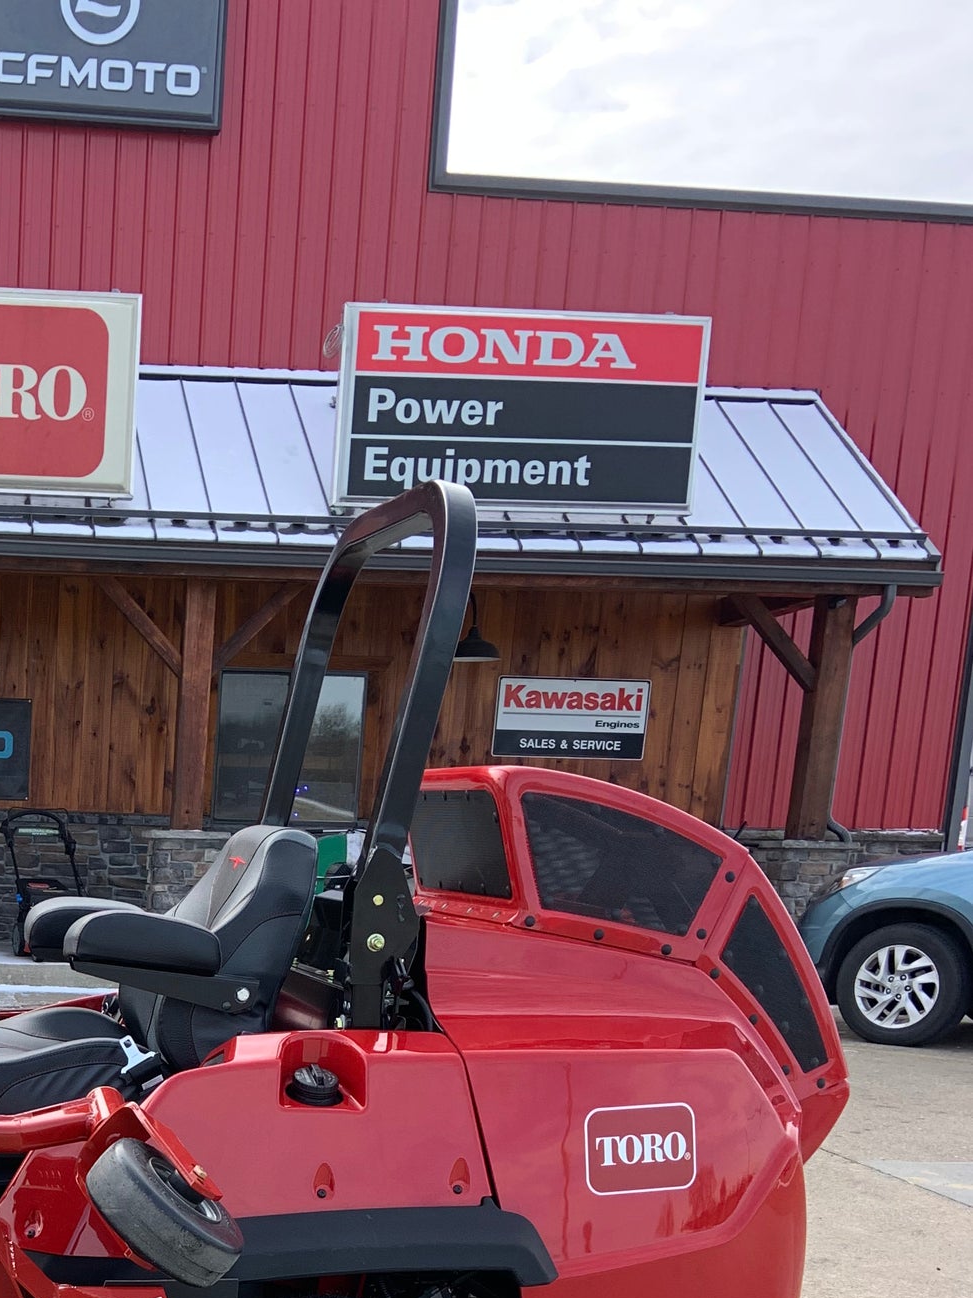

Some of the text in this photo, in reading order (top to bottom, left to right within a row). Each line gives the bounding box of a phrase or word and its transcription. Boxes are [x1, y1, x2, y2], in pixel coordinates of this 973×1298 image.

[371, 324, 637, 370] HONDA
[367, 387, 504, 426] Power
[363, 446, 592, 490] Equipment
[503, 684, 644, 712] Kawasaki
[594, 719, 640, 730] Engines
[519, 737, 622, 751] SALES & SERVICE
[595, 1131, 687, 1167] TORO
